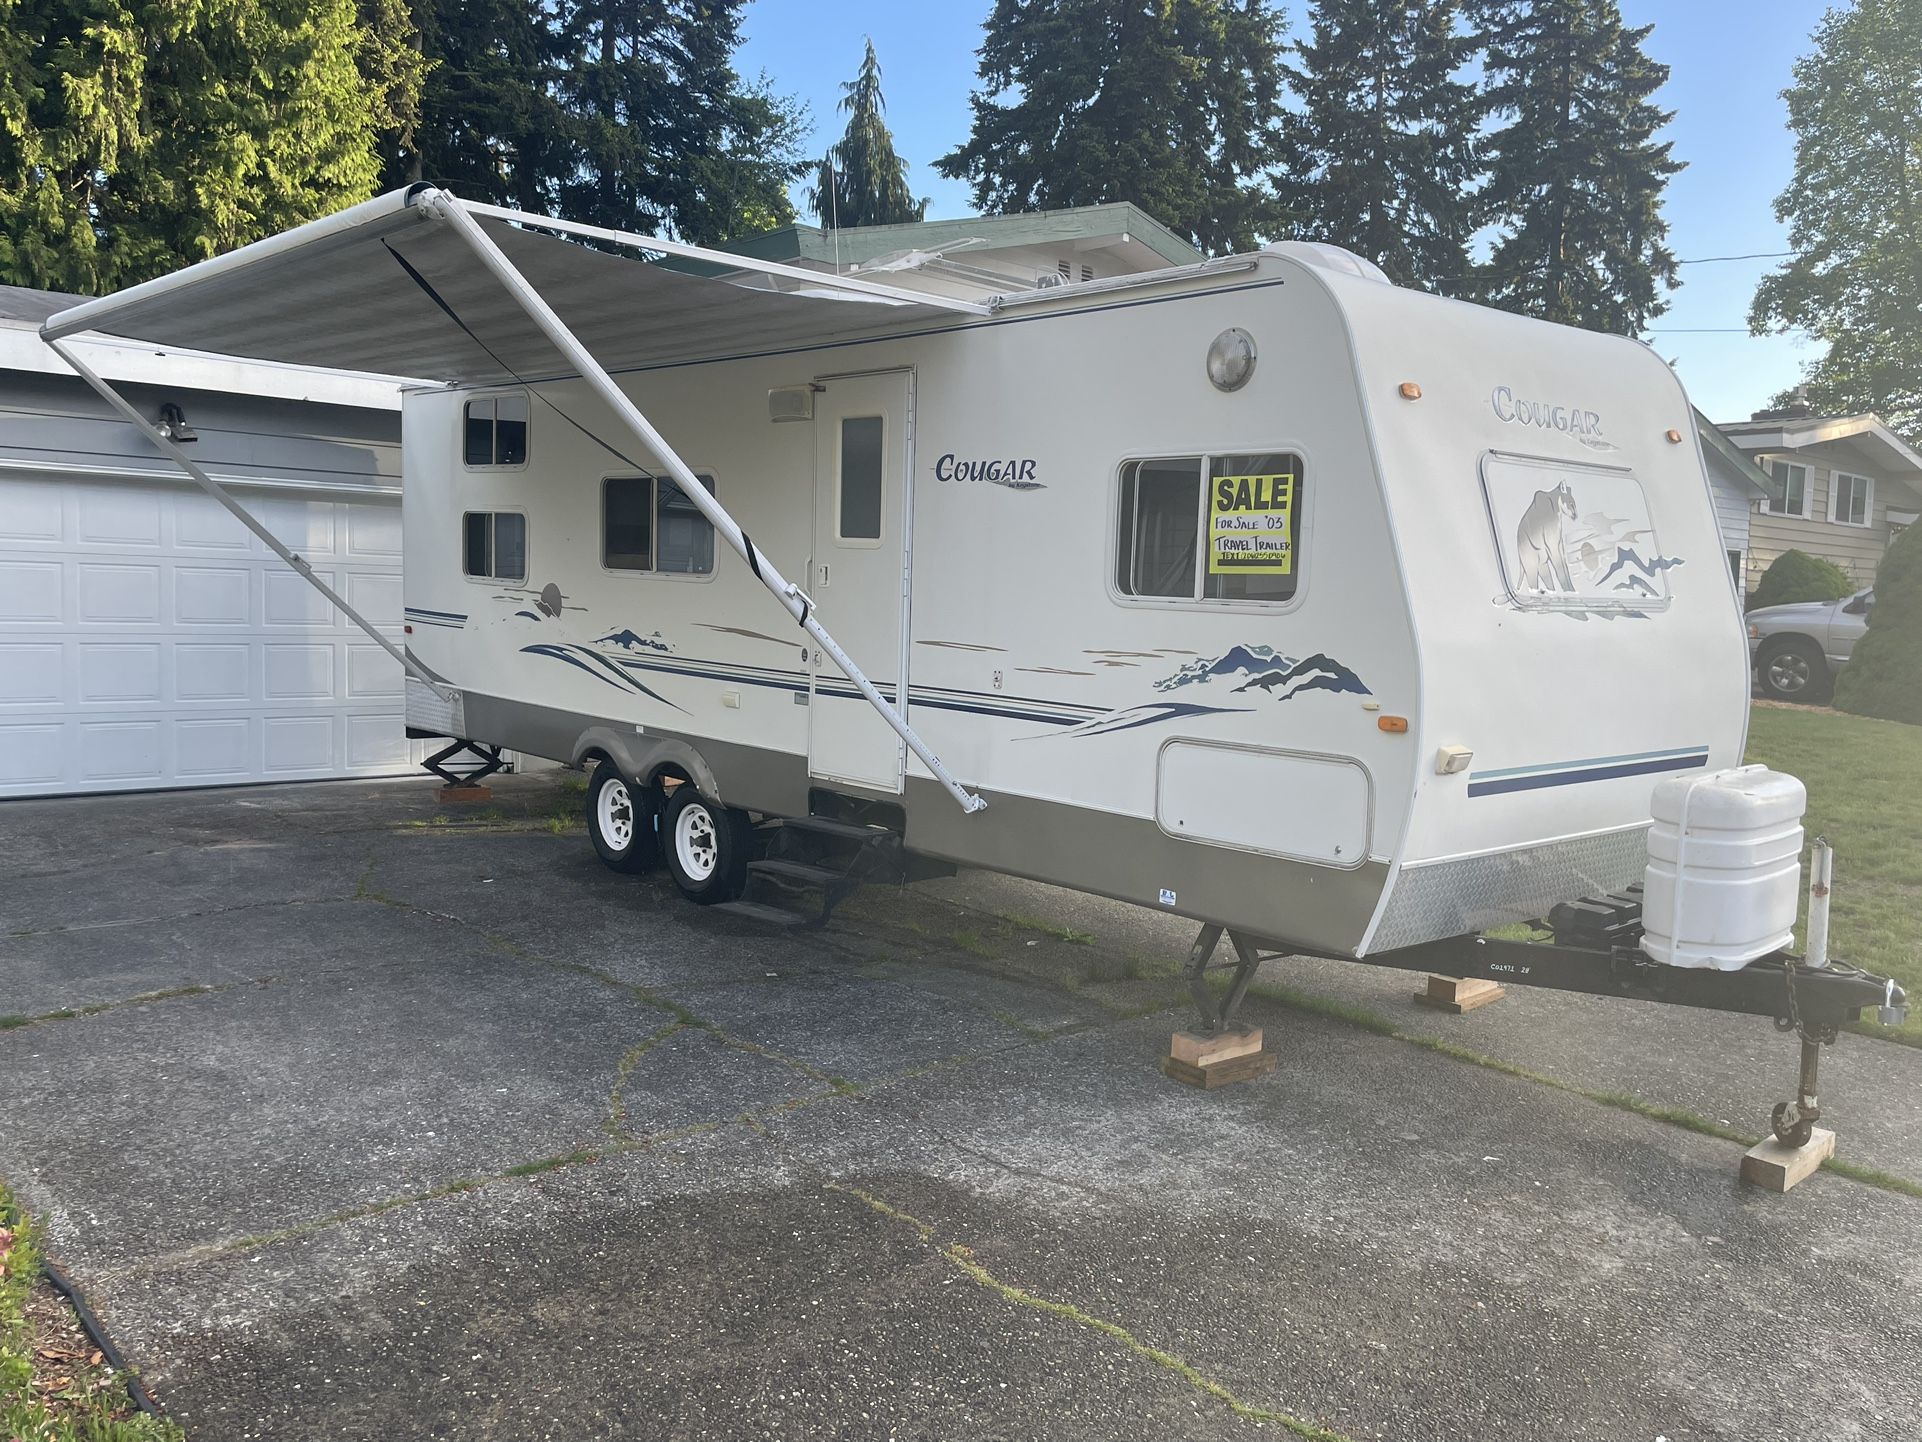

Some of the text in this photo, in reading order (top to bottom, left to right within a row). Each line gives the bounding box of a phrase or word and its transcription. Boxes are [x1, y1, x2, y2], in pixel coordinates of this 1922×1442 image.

[1492, 386, 1602, 435] COUGAR
[936, 454, 1036, 481] COUGAR
[1217, 477, 1289, 511] SALE
[1215, 515, 1283, 529] FOR SALE '03
[1215, 536, 1290, 551] TRAVEL TRAILER
